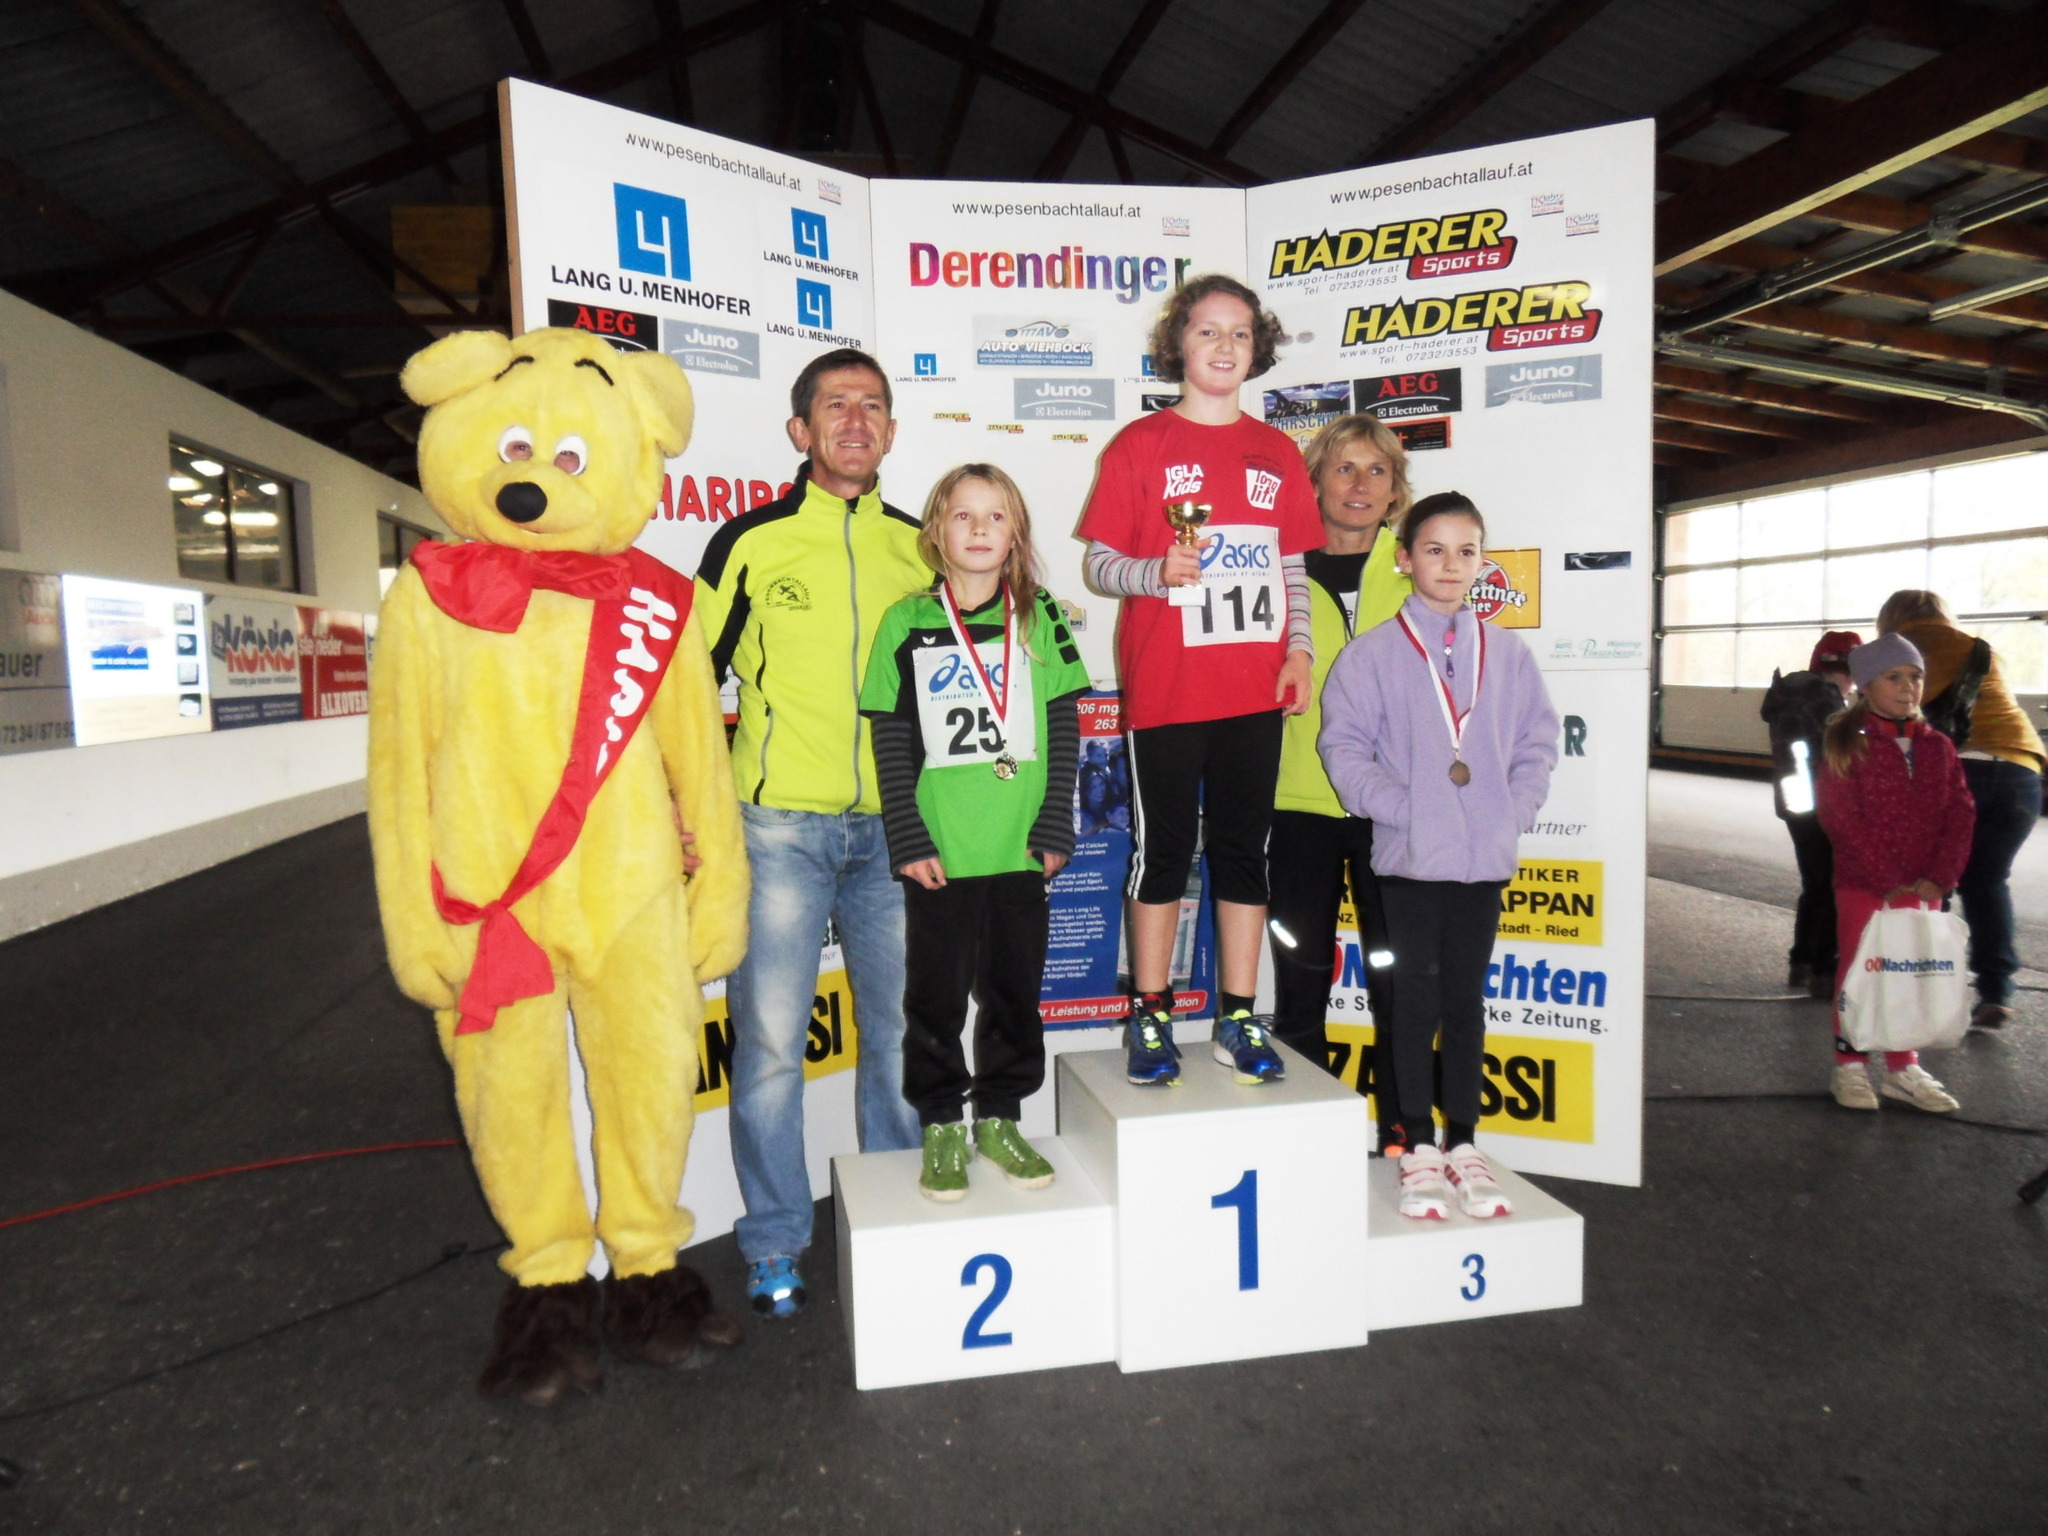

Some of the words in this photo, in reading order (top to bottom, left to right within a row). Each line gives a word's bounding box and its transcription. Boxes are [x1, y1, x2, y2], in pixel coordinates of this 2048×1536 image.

[625, 133, 801, 192] www.pesenbachtallauf.at
[1330, 161, 1534, 204] www.pesenbachtallauf.at
[952, 202, 1141, 219] www.pesenbachtallauf.at
[1270, 210, 1507, 278] HADERER
[763, 250, 792, 267] LANG
[794, 257, 805, 269] U.
[805, 260, 859, 282] MENHOFER
[909, 242, 1191, 305] Derendinger
[1422, 249, 1501, 276] Sports
[551, 264, 611, 292] LANG
[619, 277, 638, 297] U.
[642, 280, 751, 317] MENHOFER
[1329, 275, 1398, 292] 07232/3553
[572, 304, 637, 336] AEG
[1343, 281, 1592, 347] HADERER
[684, 328, 740, 350] Juno
[766, 322, 795, 338] LANG
[797, 327, 808, 340] U.
[808, 329, 862, 349] MENHOFER
[981, 341, 1019, 352] AUTO
[1024, 340, 1091, 353] VIEHBÖCK
[1502, 320, 1585, 347] Sports
[696, 354, 740, 373] Electrolux
[1405, 346, 1478, 362] 07232/3553
[1376, 372, 1440, 399] AEG
[1509, 365, 1575, 383] Juno
[1035, 382, 1092, 397] Juno
[1046, 407, 1092, 417] Electrolux
[1388, 403, 1439, 417] Electrolux
[1165, 464, 1204, 480] IGLA
[1163, 477, 1203, 500] Kids
[1221, 544, 1270, 569] asics
[1201, 585, 1275, 634] 114
[945, 707, 1006, 756] 25
[1094, 718, 1118, 730] 263
[1518, 867, 1579, 883] TIKER
[1546, 925, 1579, 937] Ried
[1050, 1005, 1098, 1018] Leistung
[1100, 1004, 1122, 1016] und
[1521, 1008, 1609, 1035] Zeitung.
[1210, 1169, 1259, 1292] 1
[1460, 1253, 1487, 1301] 3
[960, 1253, 1014, 1351] 2
